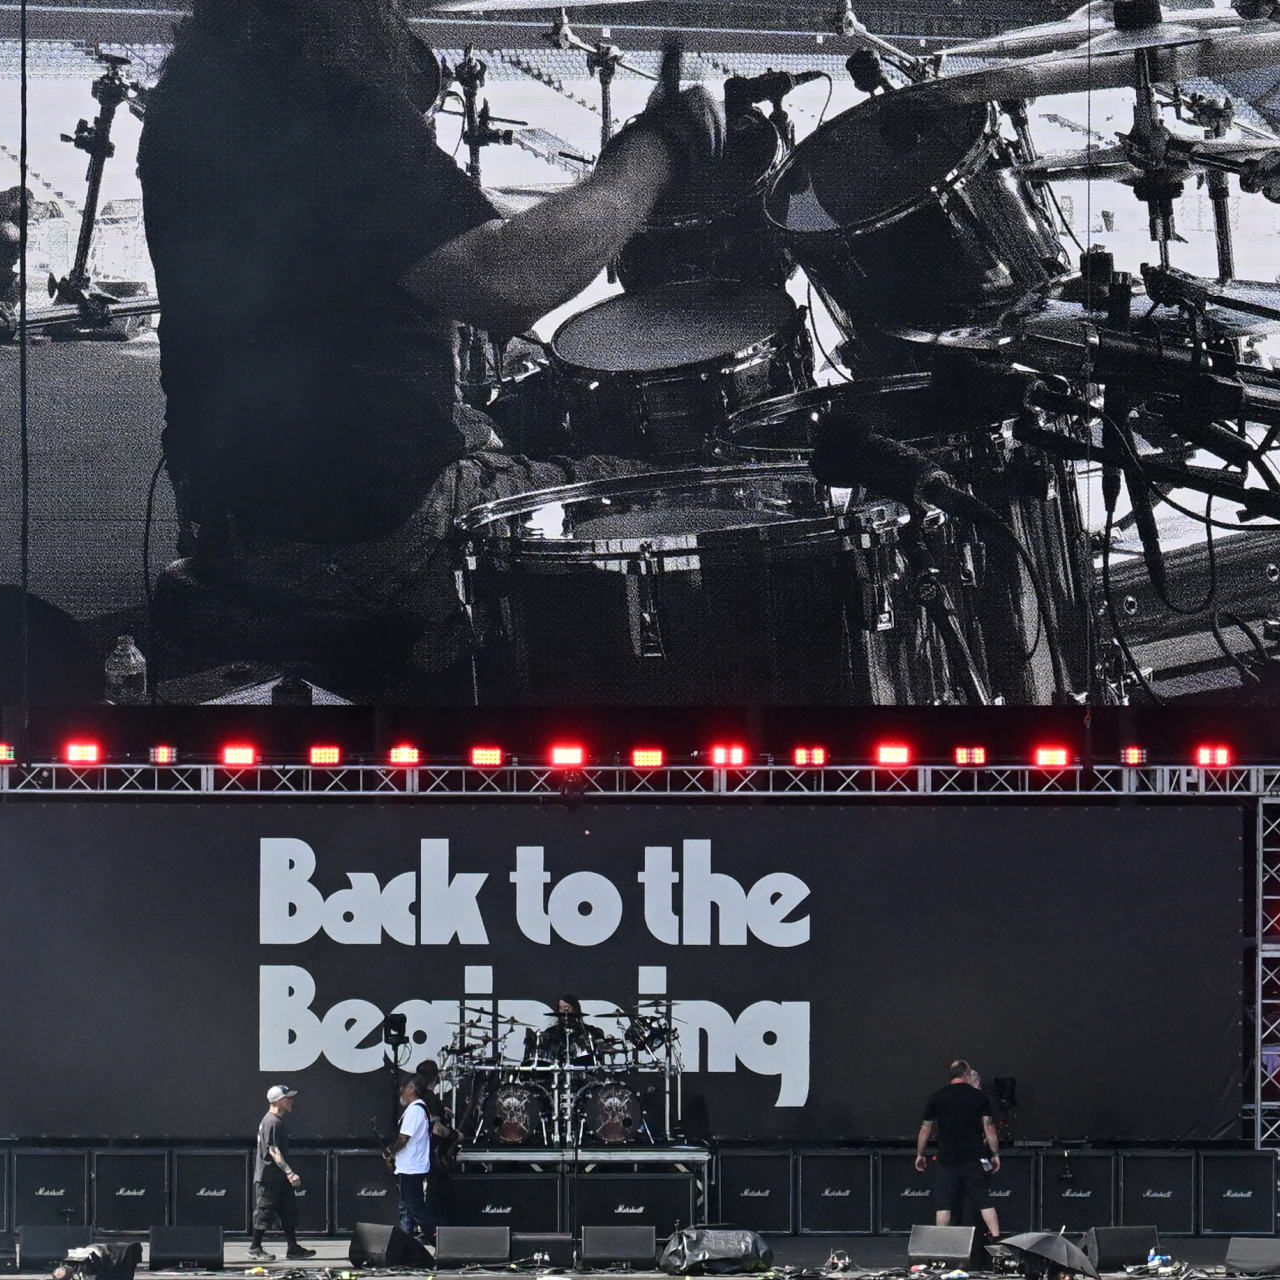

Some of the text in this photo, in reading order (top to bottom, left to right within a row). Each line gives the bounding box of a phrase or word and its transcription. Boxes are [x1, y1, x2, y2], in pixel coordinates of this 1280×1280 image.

[259, 837, 811, 948] Back to the
[481, 1204, 513, 1214] Marshall
[614, 1204, 645, 1214] Marshall
